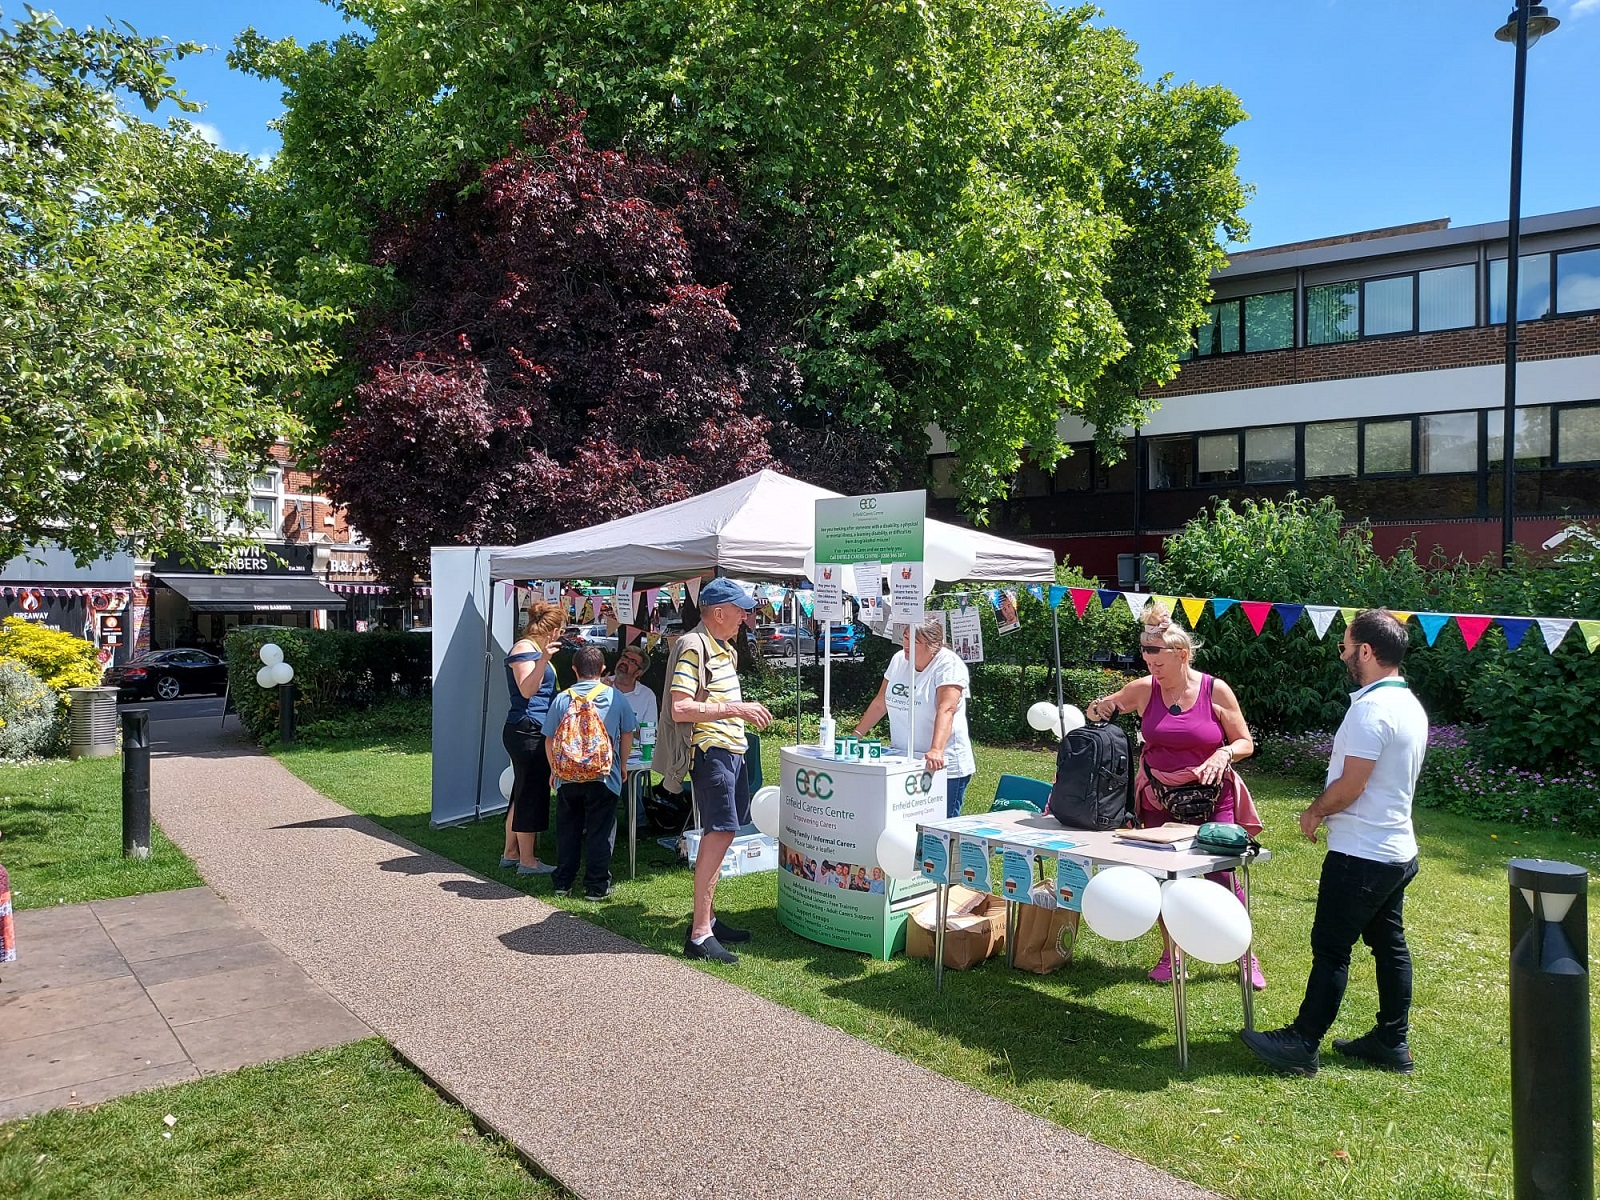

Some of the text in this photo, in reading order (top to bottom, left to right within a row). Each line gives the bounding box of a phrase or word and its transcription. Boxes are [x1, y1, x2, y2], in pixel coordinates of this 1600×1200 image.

[892, 796, 944, 811] Enfield Carers Centre
[802, 802, 824, 815] Carers
[826, 806, 854, 820] Centre
[820, 820, 836, 830] Carers
[813, 836, 836, 845] Informal
[836, 840, 856, 848] Carers
[808, 888, 836, 900] Information
[839, 902, 858, 912] Training
[854, 913, 874, 921] Support
